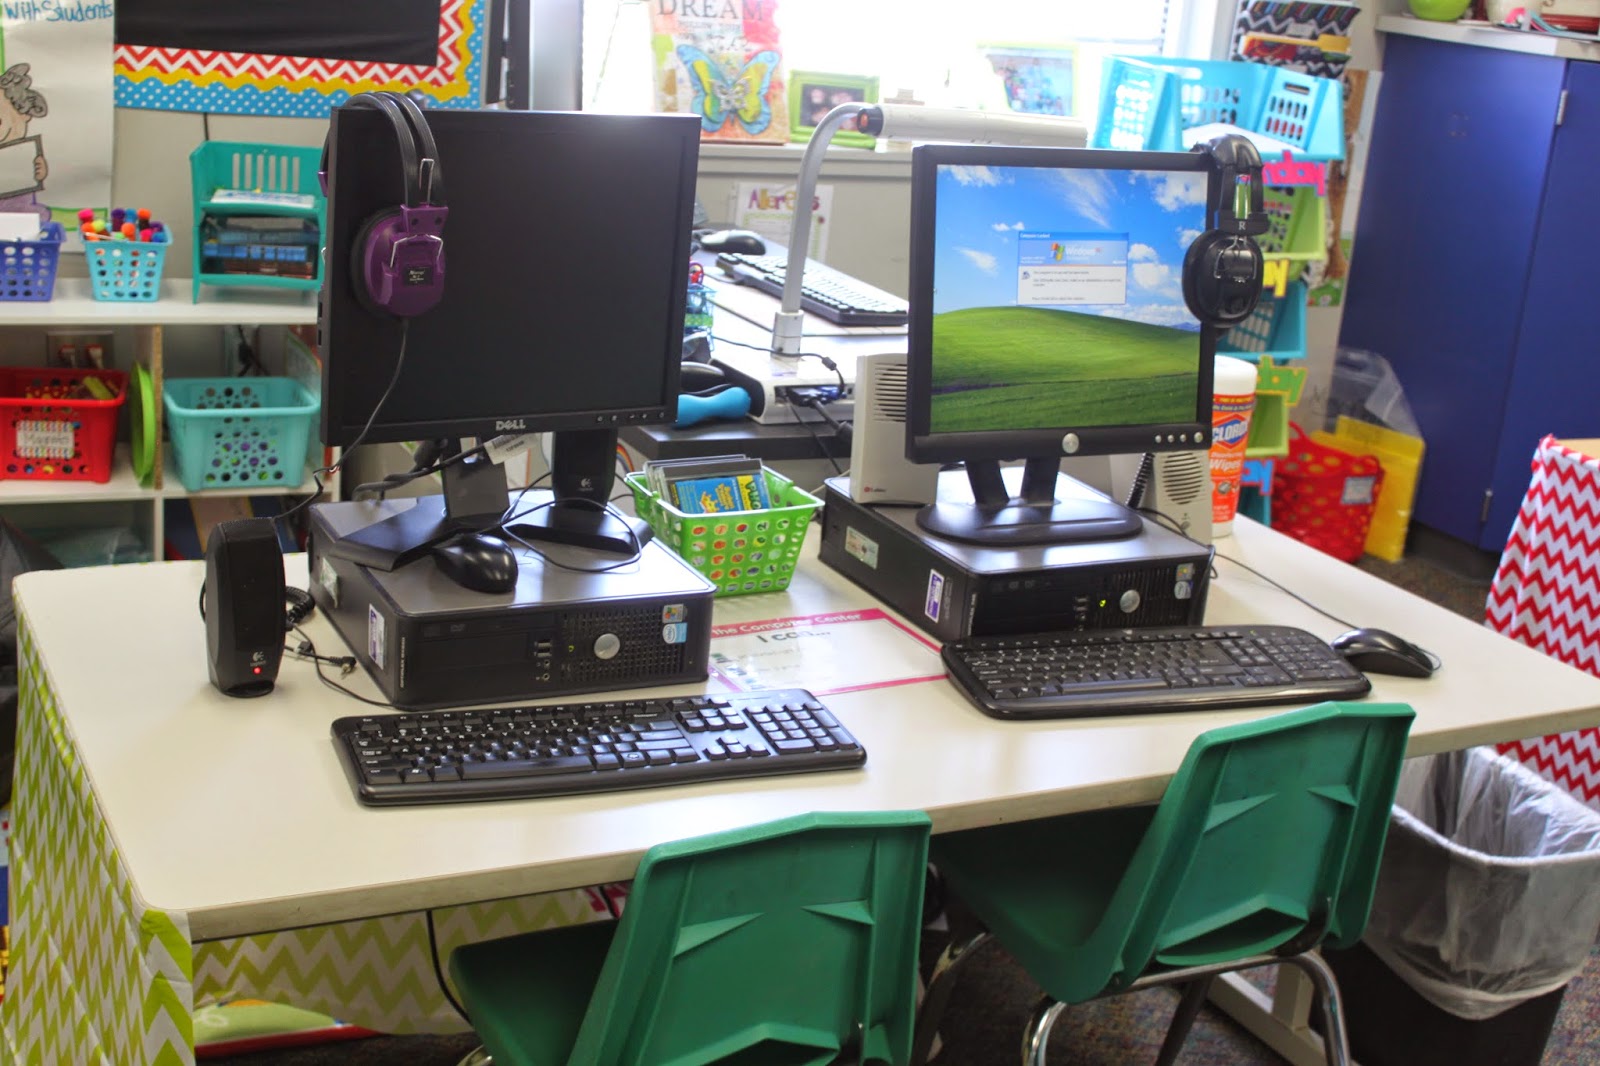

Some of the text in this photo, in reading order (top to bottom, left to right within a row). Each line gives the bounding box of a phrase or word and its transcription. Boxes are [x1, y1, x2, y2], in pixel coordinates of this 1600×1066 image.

[41, 0, 114, 22] Students
[657, 0, 765, 21] DREAM
[1238, 220, 1246, 231] R
[495, 419, 527, 431] DELL
[815, 613, 861, 623] Center
